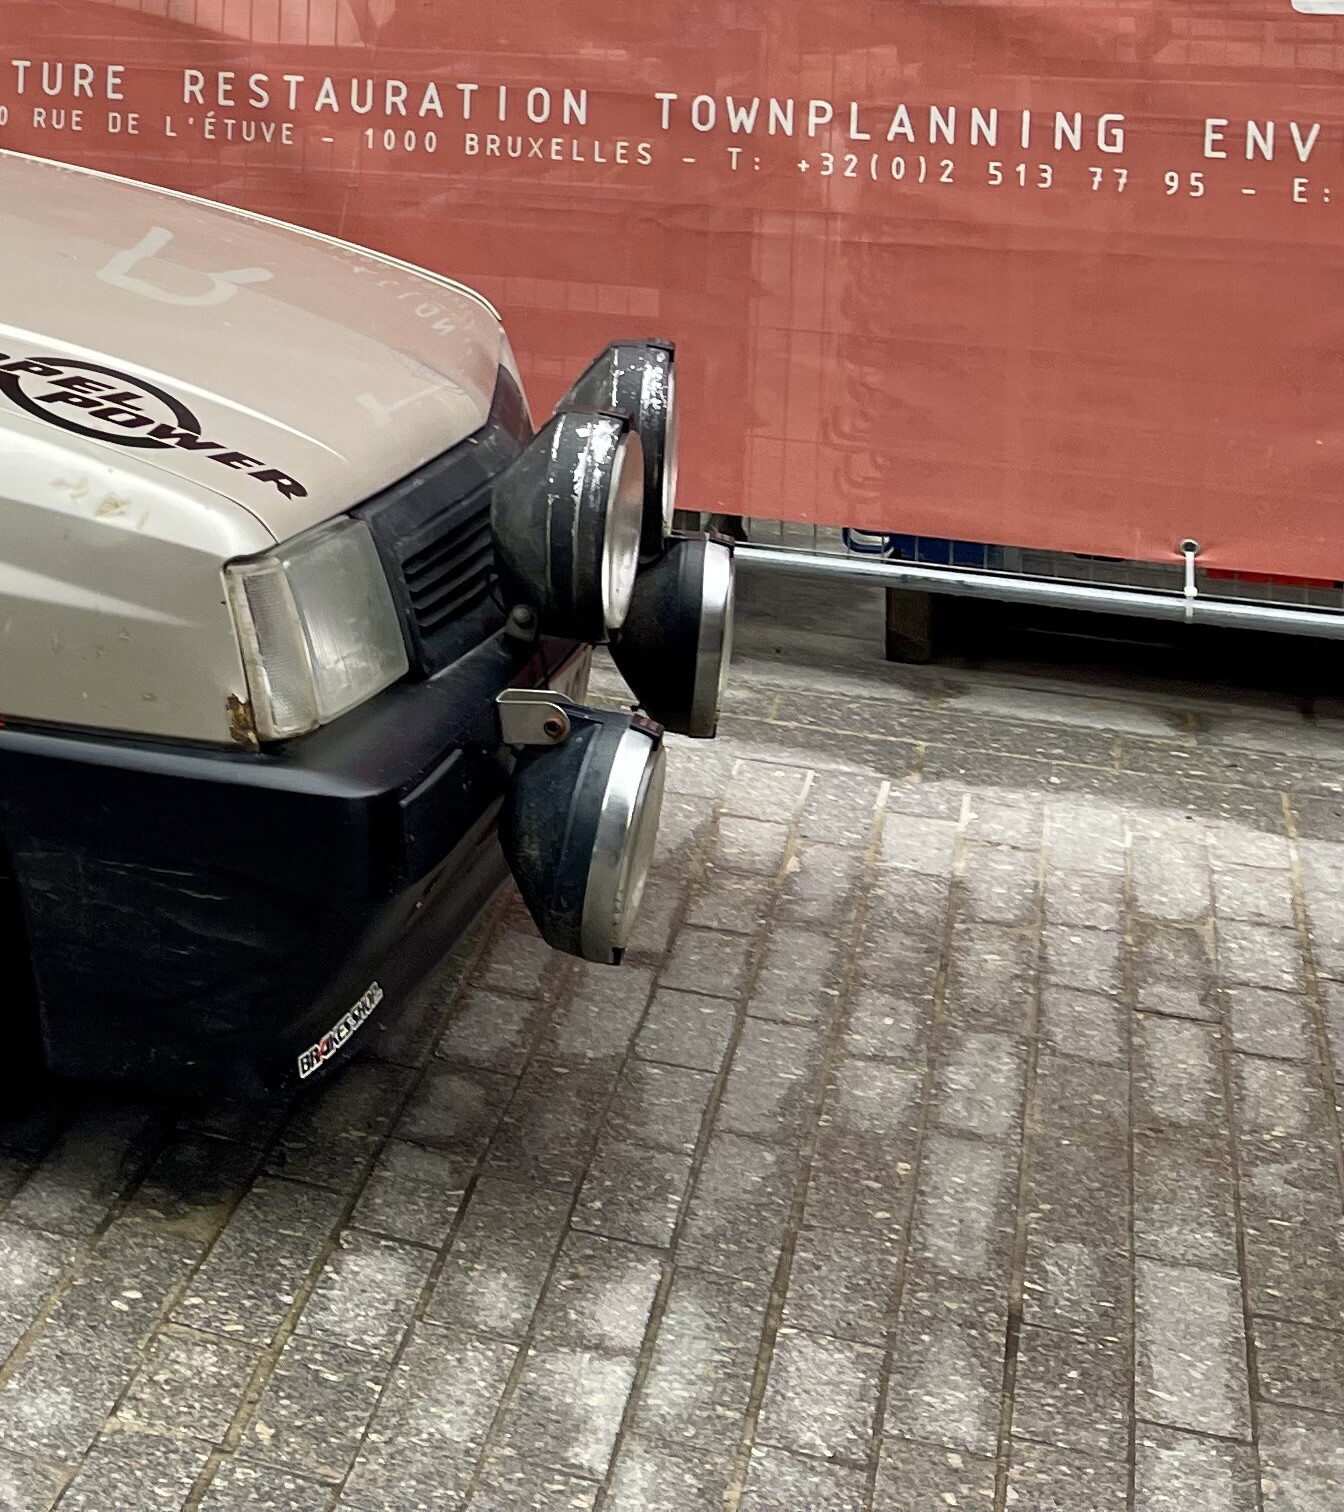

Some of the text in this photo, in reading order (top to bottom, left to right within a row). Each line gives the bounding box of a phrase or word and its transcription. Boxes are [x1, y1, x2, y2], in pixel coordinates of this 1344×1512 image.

[32, 107, 83, 131] RUE
[108, 111, 140, 135] DE
[165, 111, 294, 145] L'ÉTUVE
[365, 127, 438, 154] 1000
[464, 133, 653, 165] BRUXELLES
[726, 147, 761, 172] T:
[797, 152, 955, 184] +32(0)2
[988, 161, 1053, 189] 513
[1088, 166, 1129, 193] 77
[1164, 171, 1205, 197] 95
[1292, 177, 1331, 204] E:
[183, 69, 588, 126] RESTAURATION
[654, 91, 1125, 154] TOWNPLANNING
[1204, 118, 1321, 163] ENV
[34, 390, 309, 502] POWER
